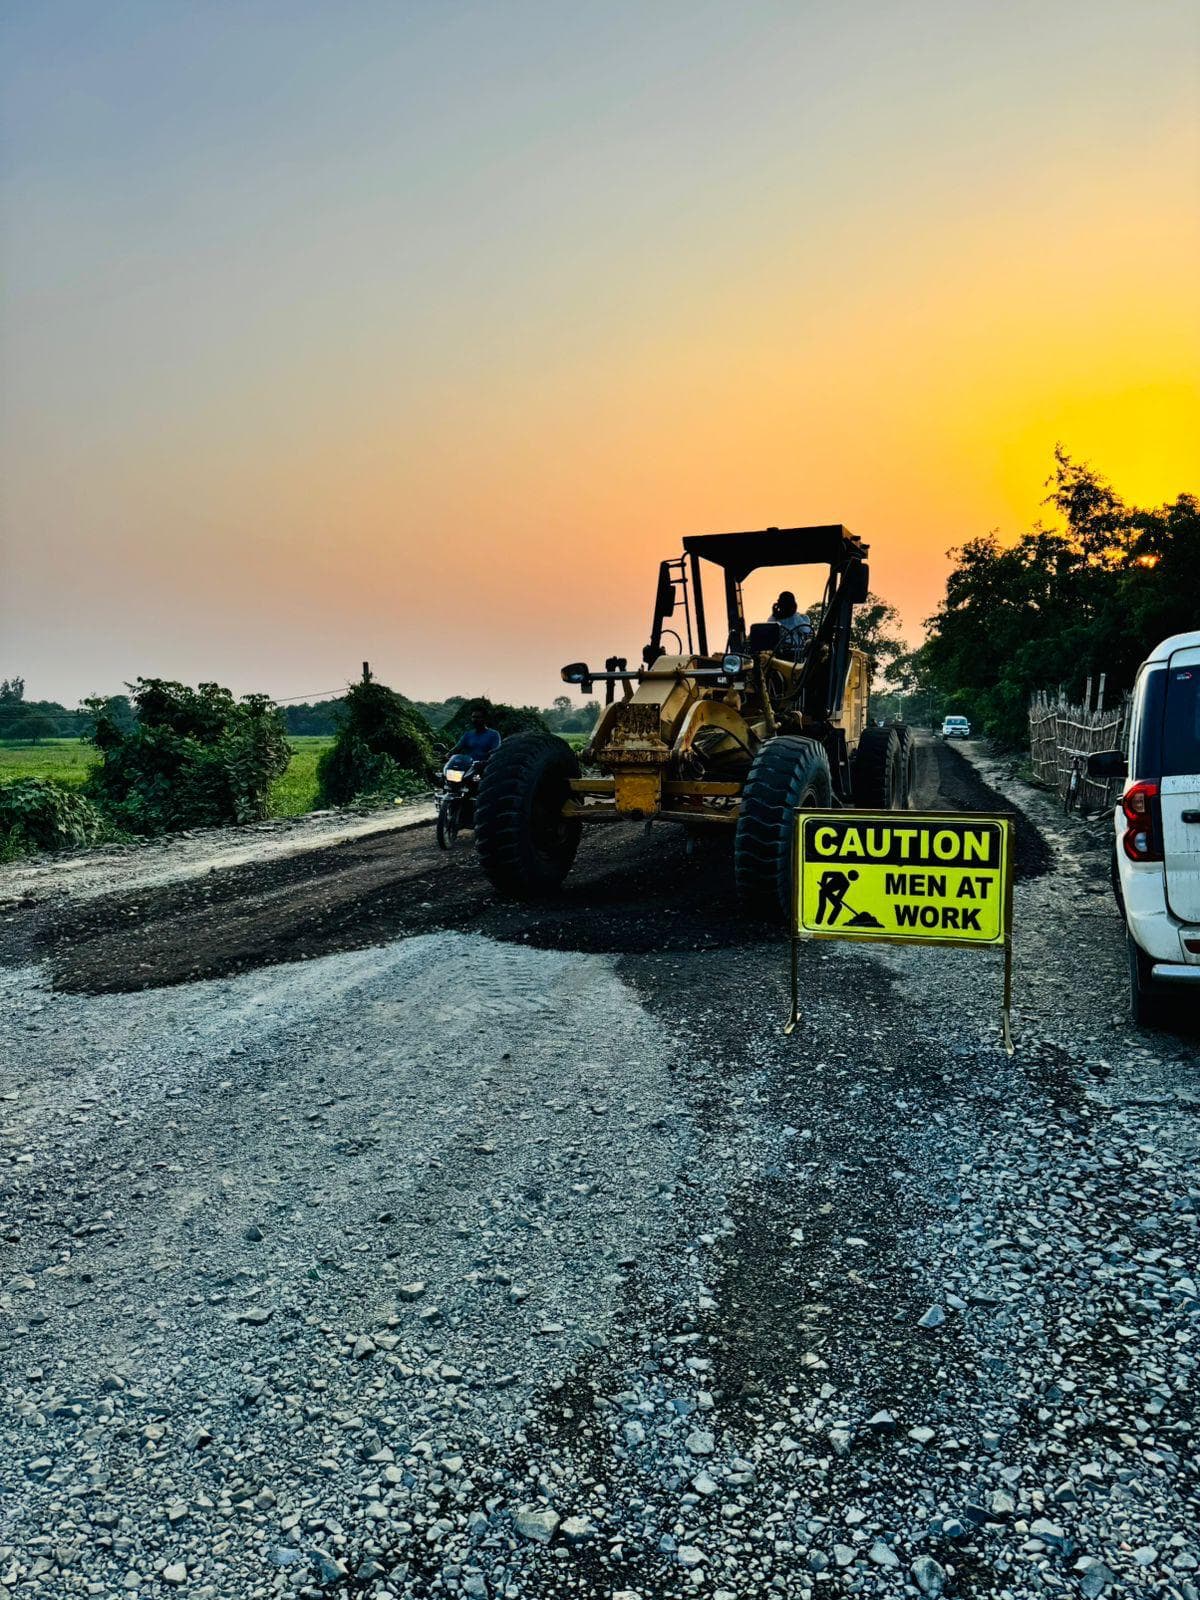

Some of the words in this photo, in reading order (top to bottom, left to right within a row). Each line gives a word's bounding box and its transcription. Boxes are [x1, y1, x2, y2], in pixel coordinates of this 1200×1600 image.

[814, 827, 990, 861] CAUTION
[885, 873, 946, 897] MEN
[957, 877, 993, 899] AT
[894, 905, 981, 930] WORK
